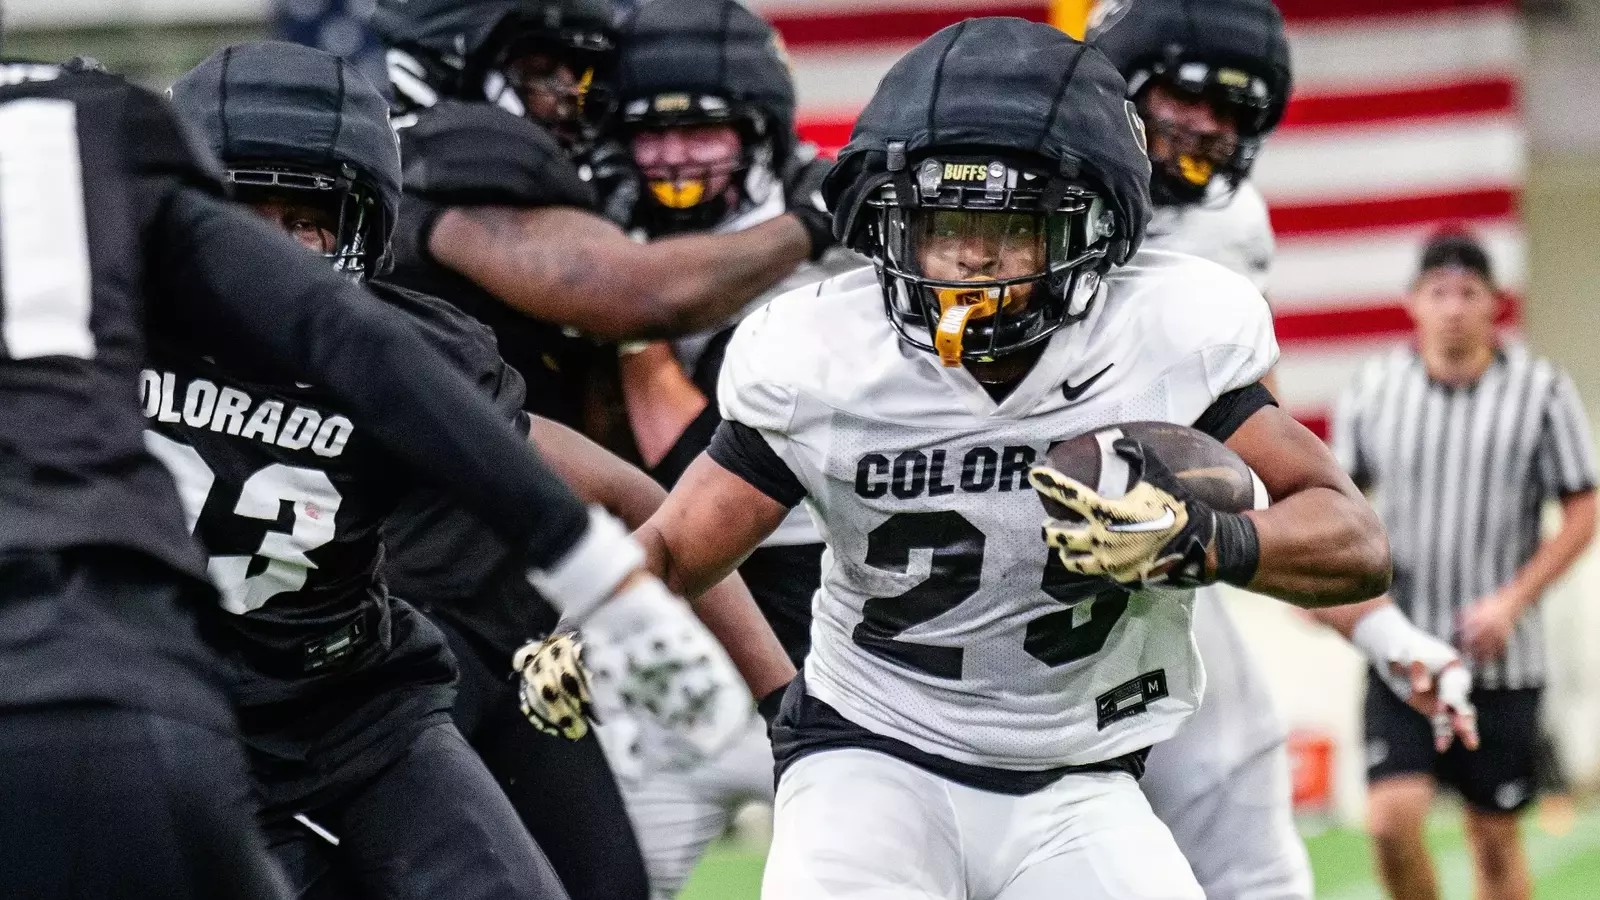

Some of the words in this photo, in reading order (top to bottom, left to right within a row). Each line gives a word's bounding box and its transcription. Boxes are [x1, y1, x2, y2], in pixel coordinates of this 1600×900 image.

[943, 163, 988, 181] BUFFS
[140, 369, 354, 458] OLORADO
[855, 445, 1038, 500] COLOR
[1147, 680, 1159, 694] M
